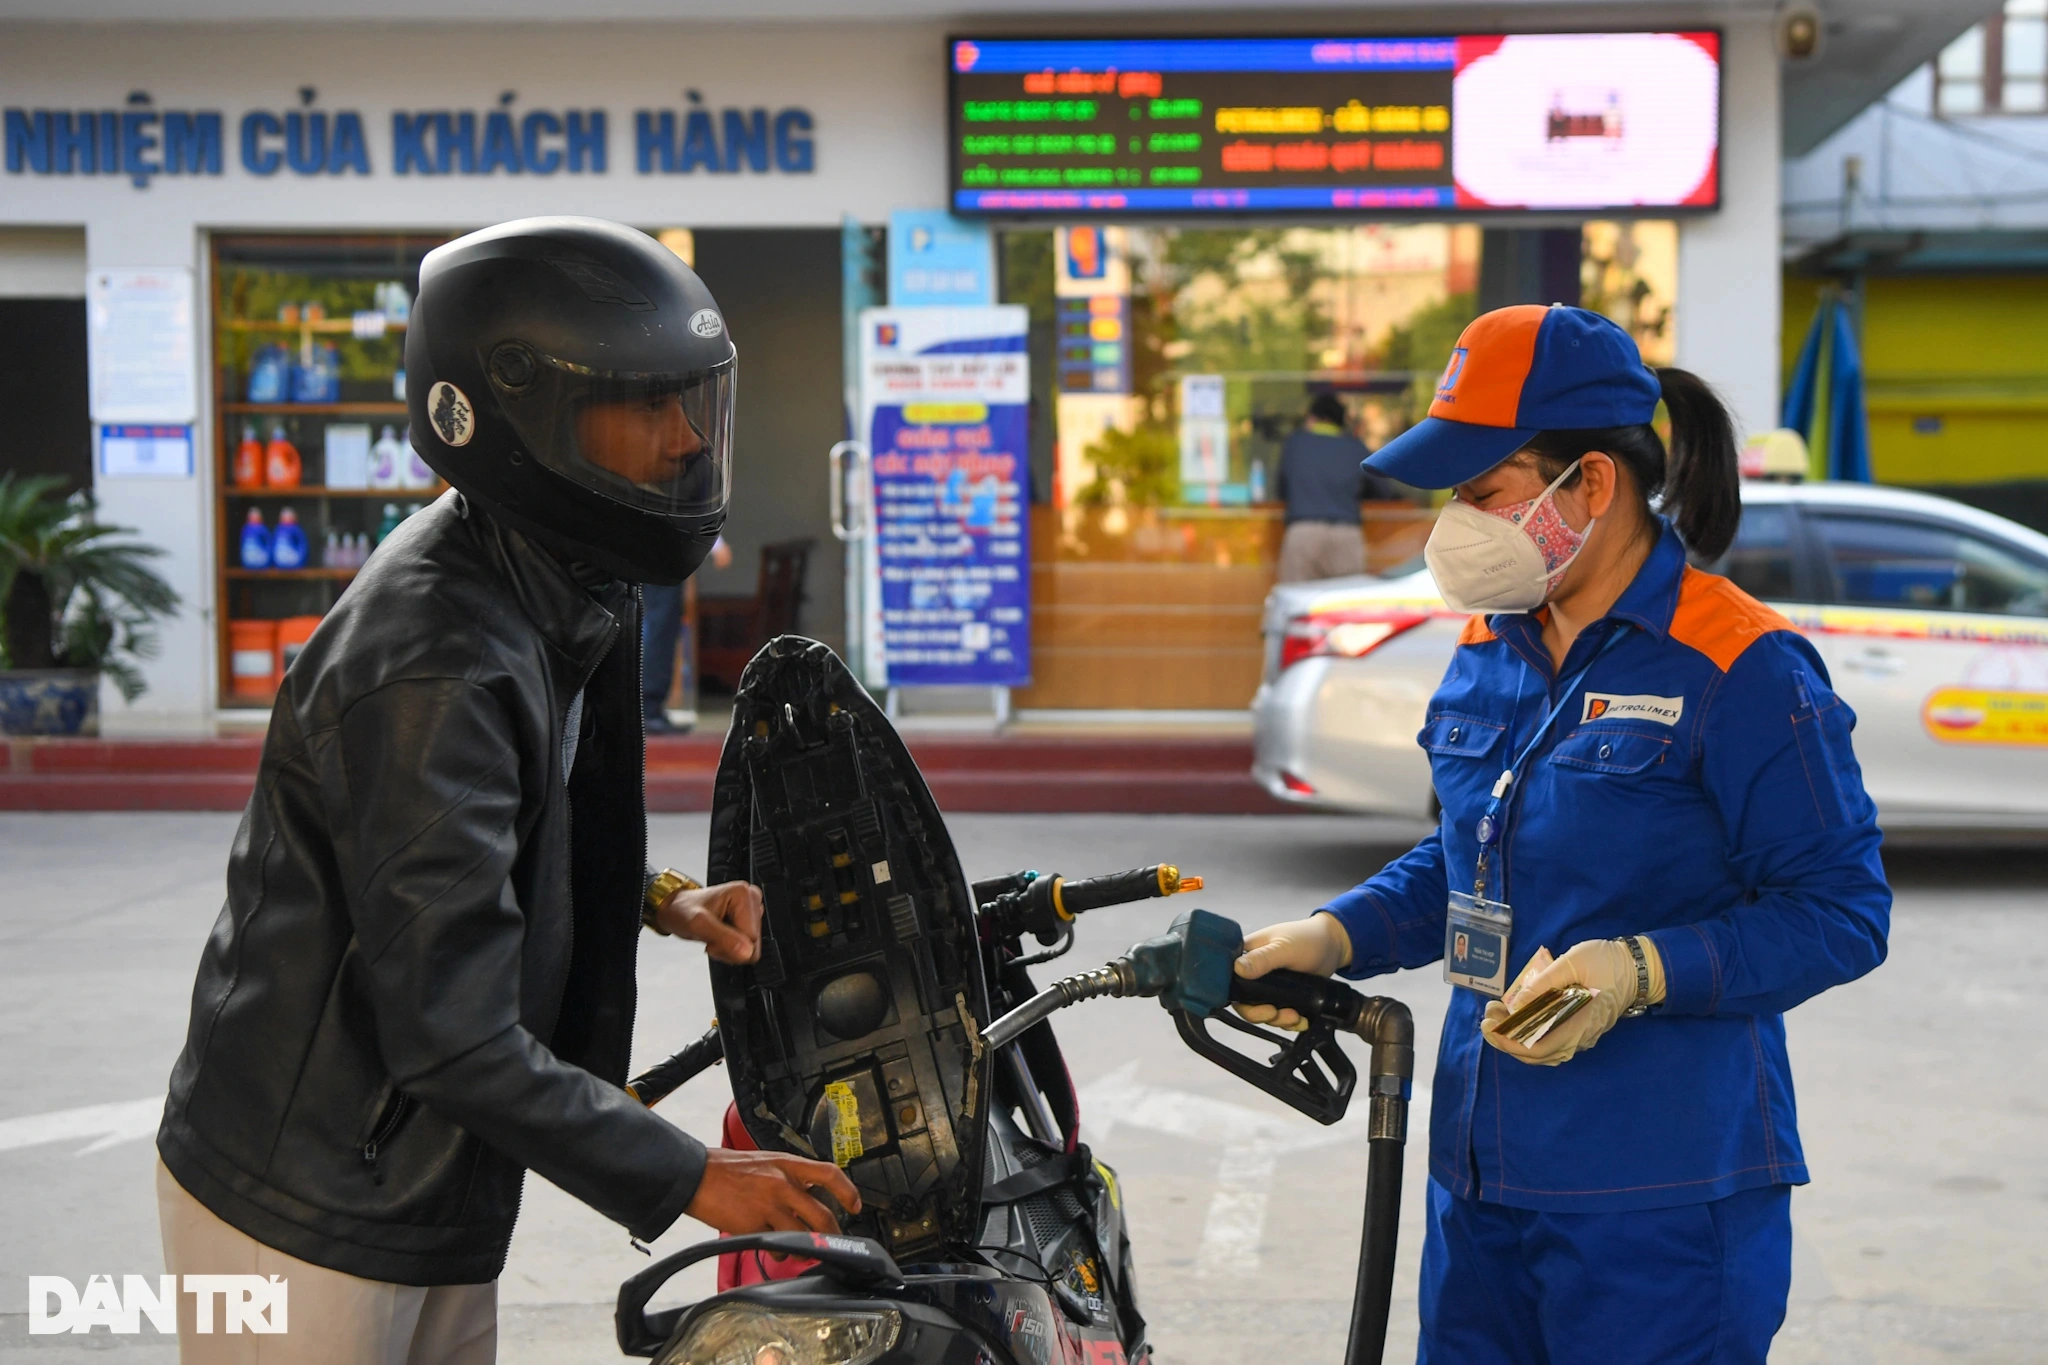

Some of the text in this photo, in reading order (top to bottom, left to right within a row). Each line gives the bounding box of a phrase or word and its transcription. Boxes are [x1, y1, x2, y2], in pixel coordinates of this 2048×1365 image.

[4, 87, 816, 188] NHIỆM CỦA KHÁCH HÀNG
[697, 314, 720, 333] Asia
[1482, 558, 1517, 576] TWN95
[1607, 704, 1679, 718] PETROLIMEX
